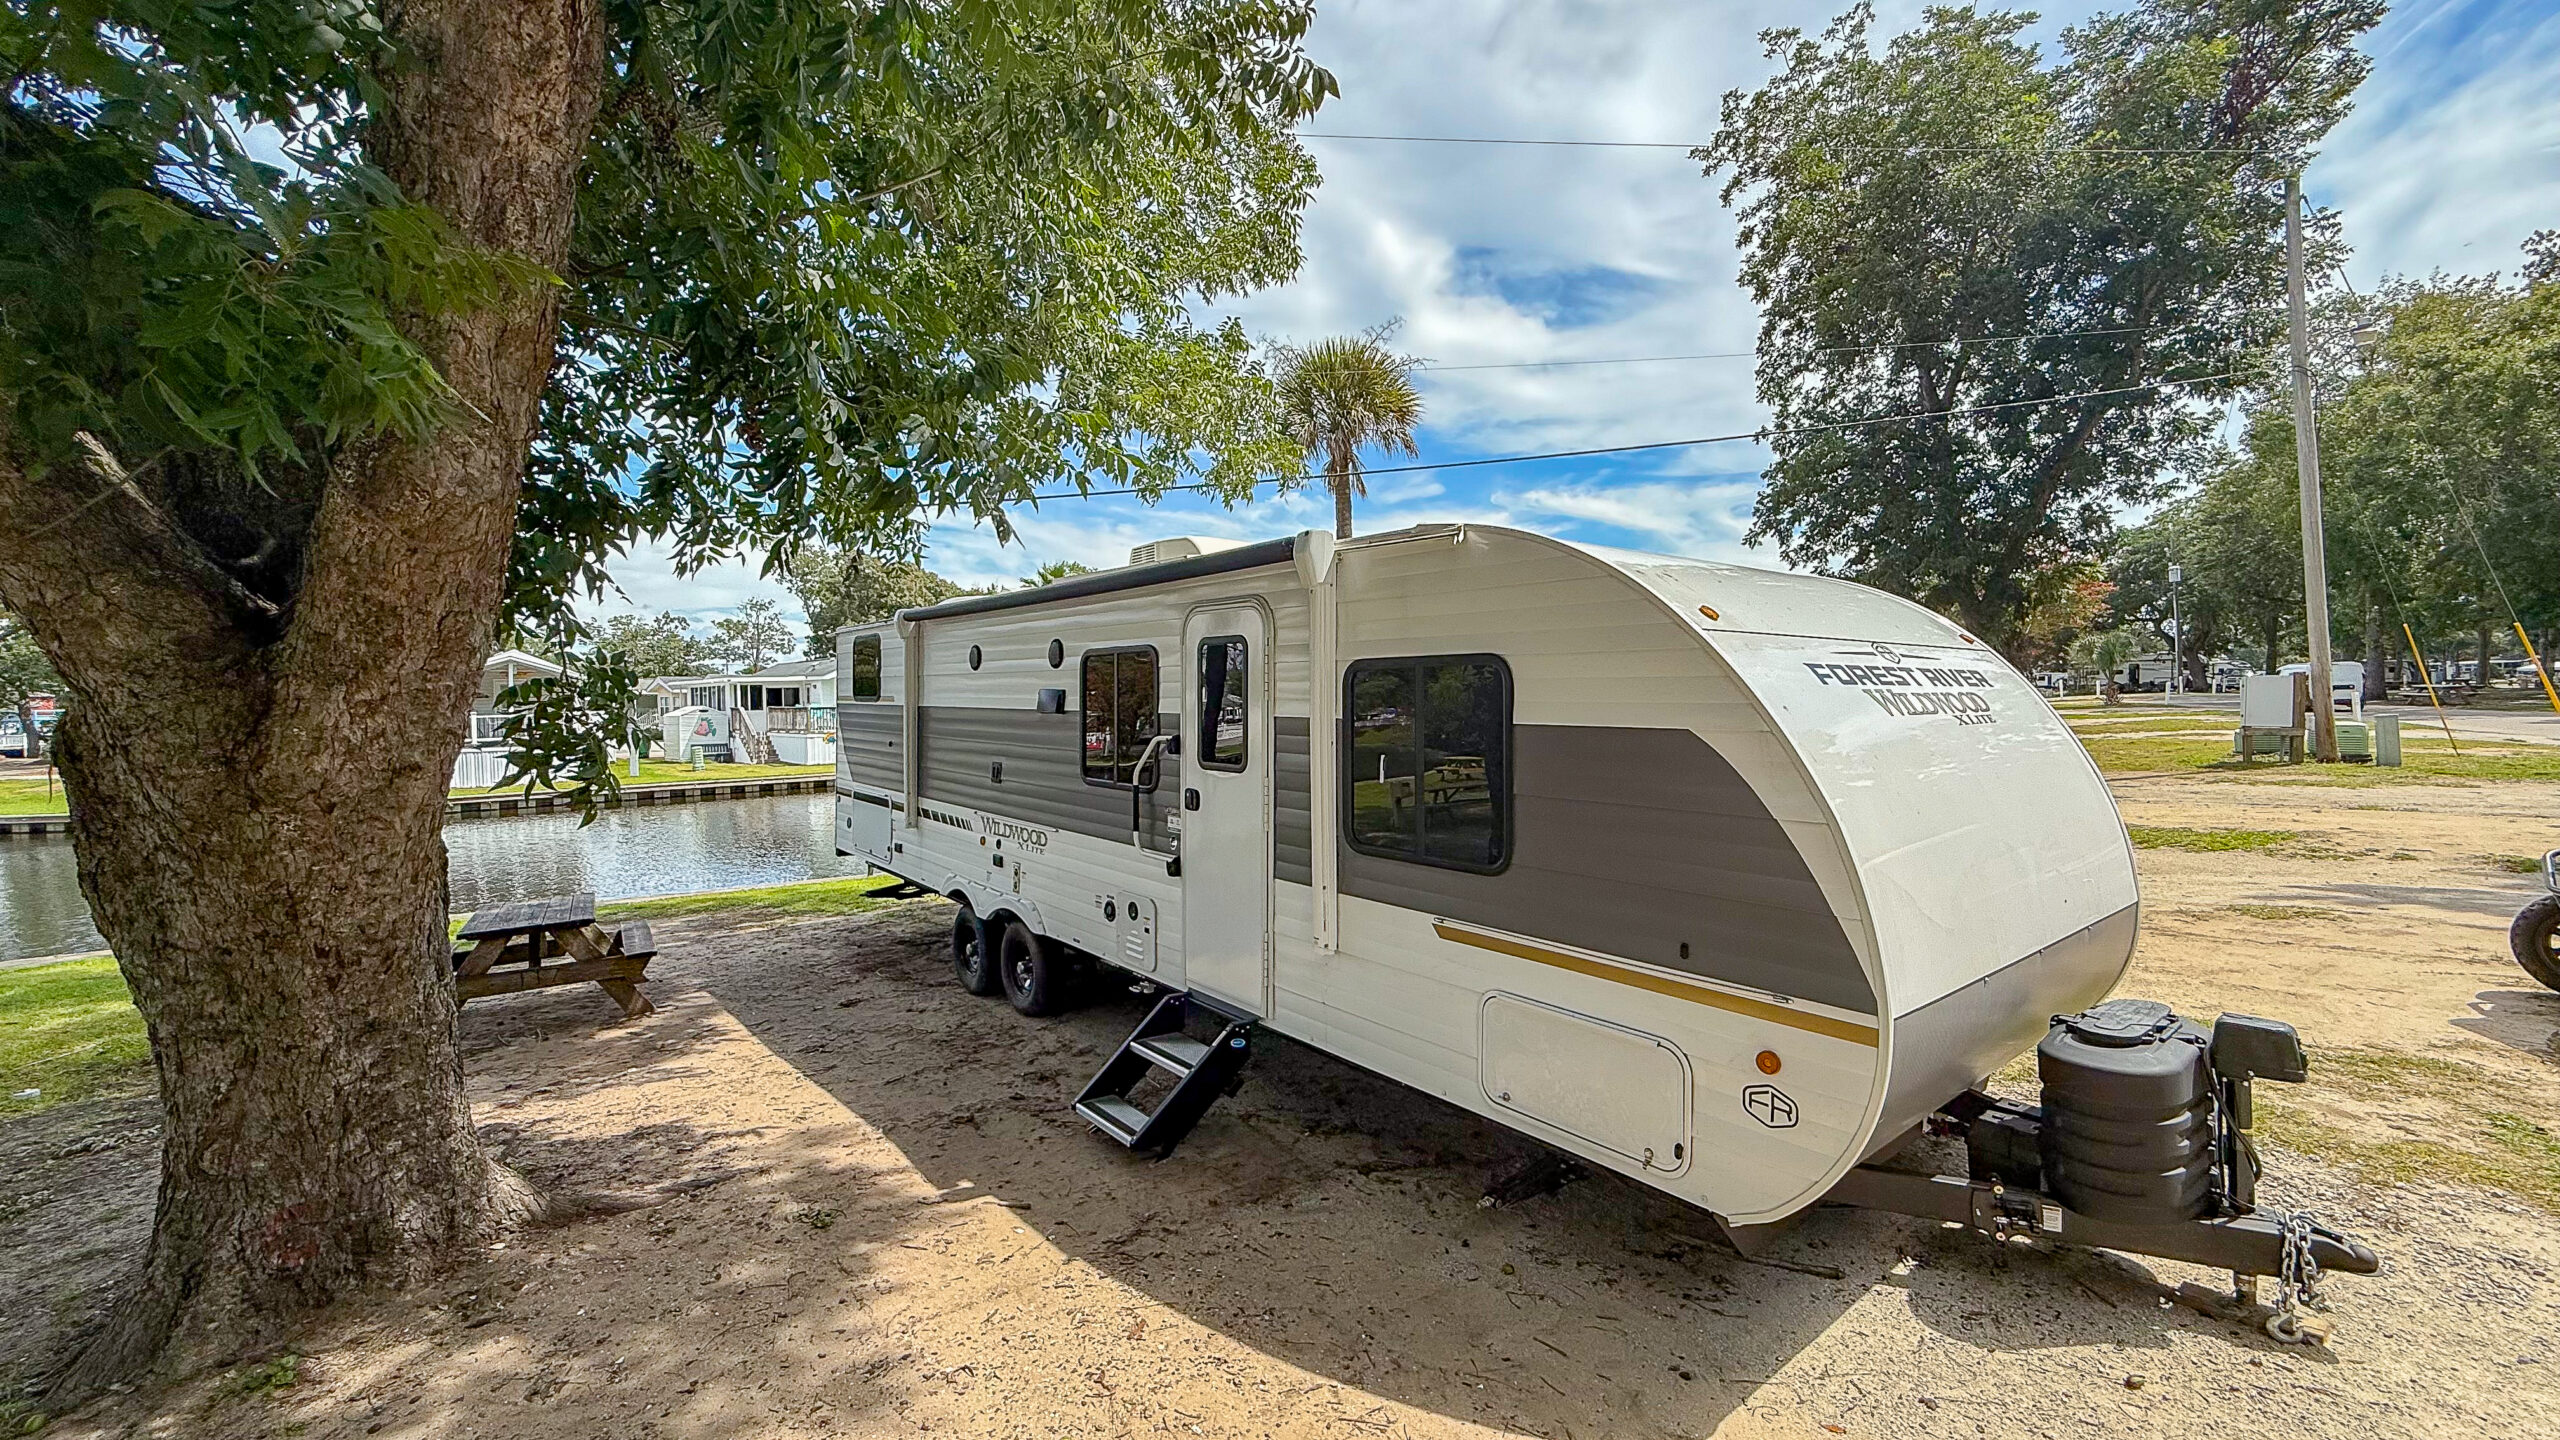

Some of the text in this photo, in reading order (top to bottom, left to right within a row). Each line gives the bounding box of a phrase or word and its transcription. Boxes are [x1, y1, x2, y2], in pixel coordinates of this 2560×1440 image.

[1803, 662, 1995, 688] FOREST RIVER
[1862, 688, 1991, 717] WILDWOOD
[980, 816, 1048, 847] WILDWOOD
[1748, 1090, 1793, 1123] FR
